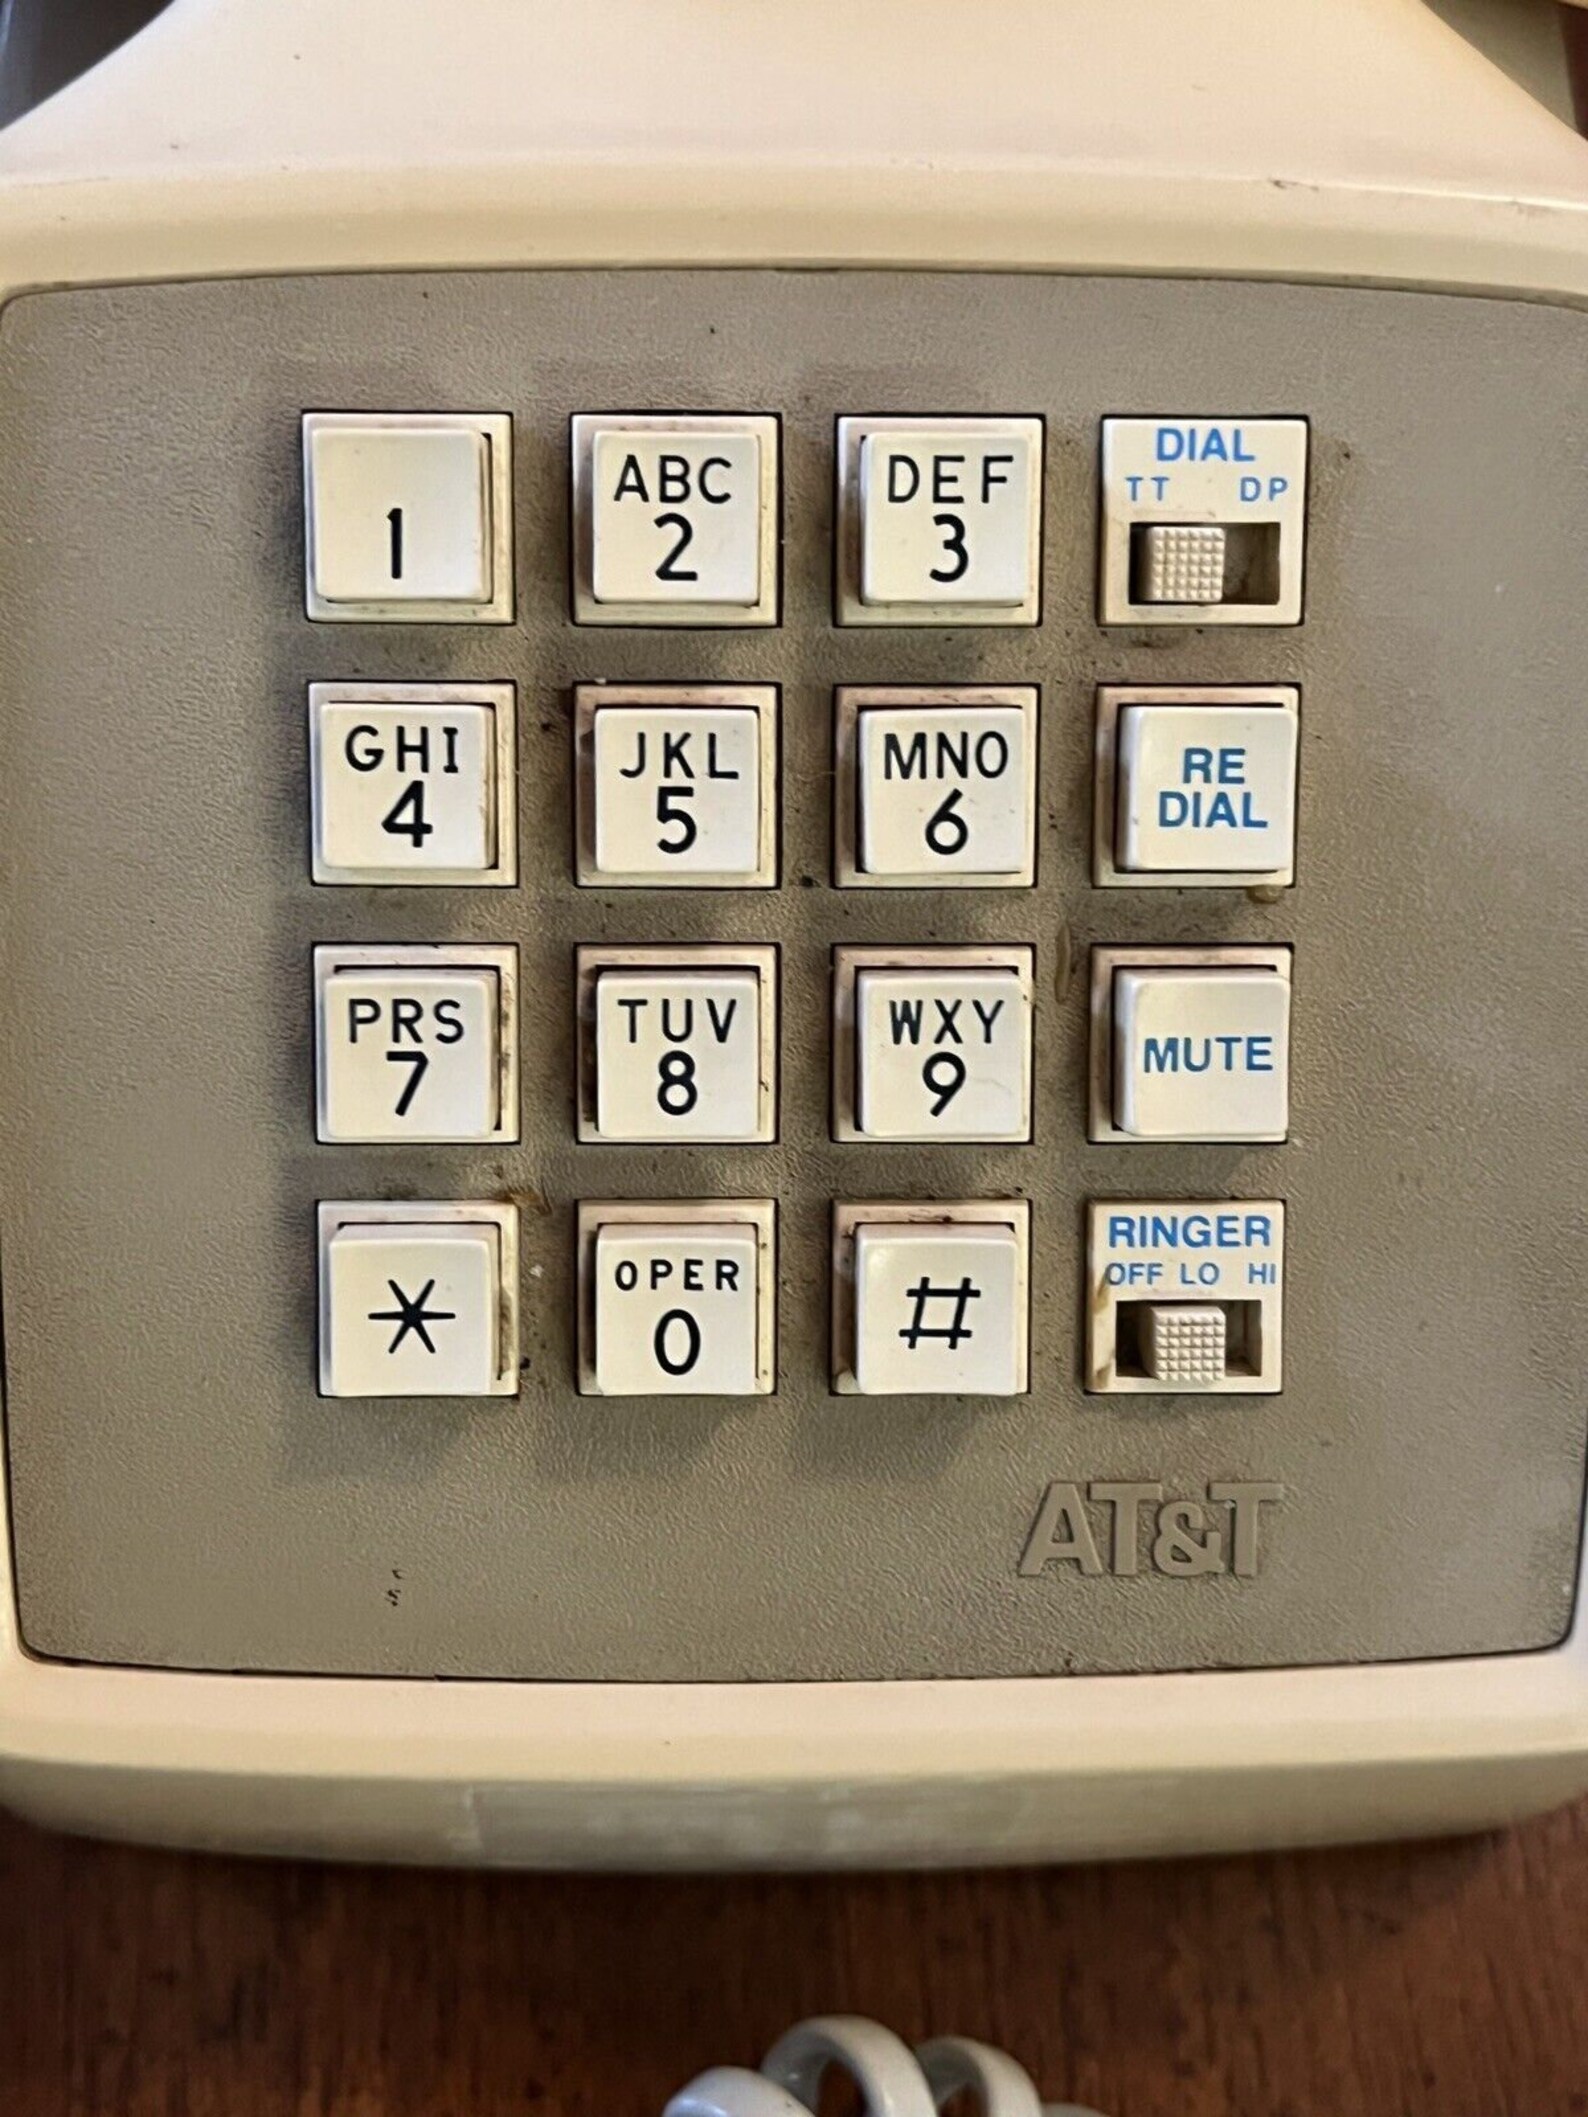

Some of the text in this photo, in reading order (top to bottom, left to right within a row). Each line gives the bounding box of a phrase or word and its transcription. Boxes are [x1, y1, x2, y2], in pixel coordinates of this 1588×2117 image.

[1157, 428, 1255, 461] DIAL
[614, 454, 732, 504] ABC
[888, 455, 1014, 504] DEF
[1126, 476, 1287, 502] TT DP
[387, 508, 402, 579] 1
[654, 512, 697, 581] 2
[930, 513, 968, 582] 3
[345, 725, 458, 773] GHI
[620, 732, 739, 779] JKL
[885, 731, 1008, 779] MNO
[1183, 748, 1246, 784] RE
[382, 780, 433, 848] 4
[657, 786, 696, 854] 5
[925, 788, 968, 855] 6
[1159, 791, 1268, 828] DIAL
[349, 999, 464, 1044] PRS
[618, 999, 736, 1043] TUV
[890, 999, 1004, 1045] WXY
[1144, 1037, 1273, 1073] MUTE
[386, 1051, 428, 1116] 7
[657, 1050, 697, 1115] 8
[922, 1052, 966, 1117] 9
[1109, 1216, 1270, 1248] RINGER
[615, 1259, 739, 1291] OPER
[1104, 1263, 1275, 1285] OFF LO HI
[1017, 1481, 1283, 1577] AT&T
